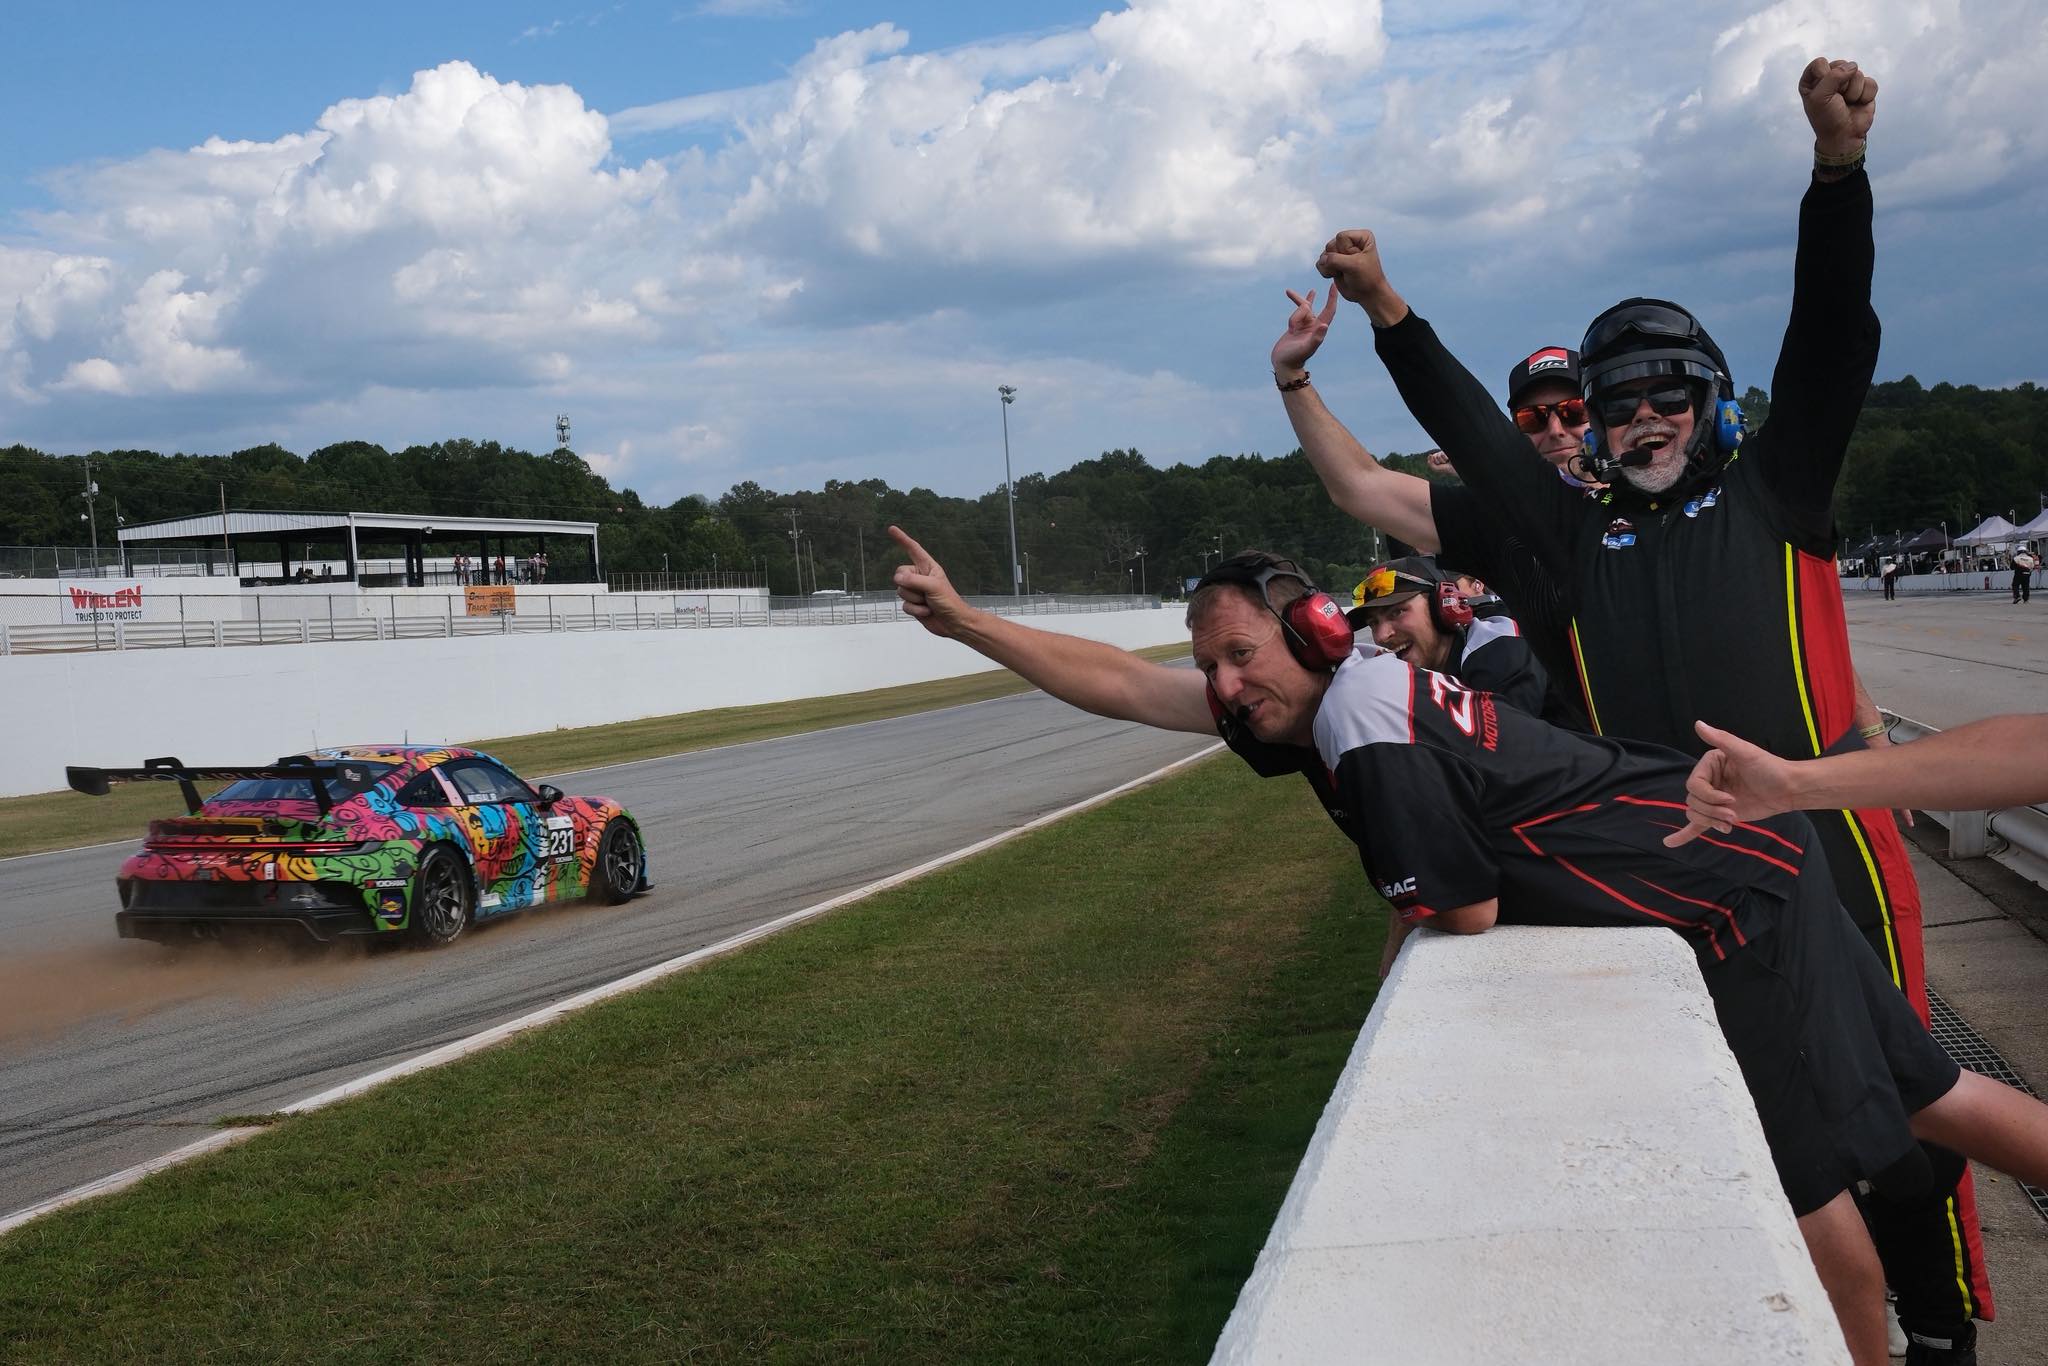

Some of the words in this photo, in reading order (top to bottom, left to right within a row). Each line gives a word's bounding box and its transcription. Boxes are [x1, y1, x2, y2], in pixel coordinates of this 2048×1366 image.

[69, 584, 143, 609] WHELEN
[75, 611, 104, 622] TRUSTED
[105, 611, 114, 621] TO
[115, 610, 142, 621] PROTECT
[550, 829, 574, 856] 231
